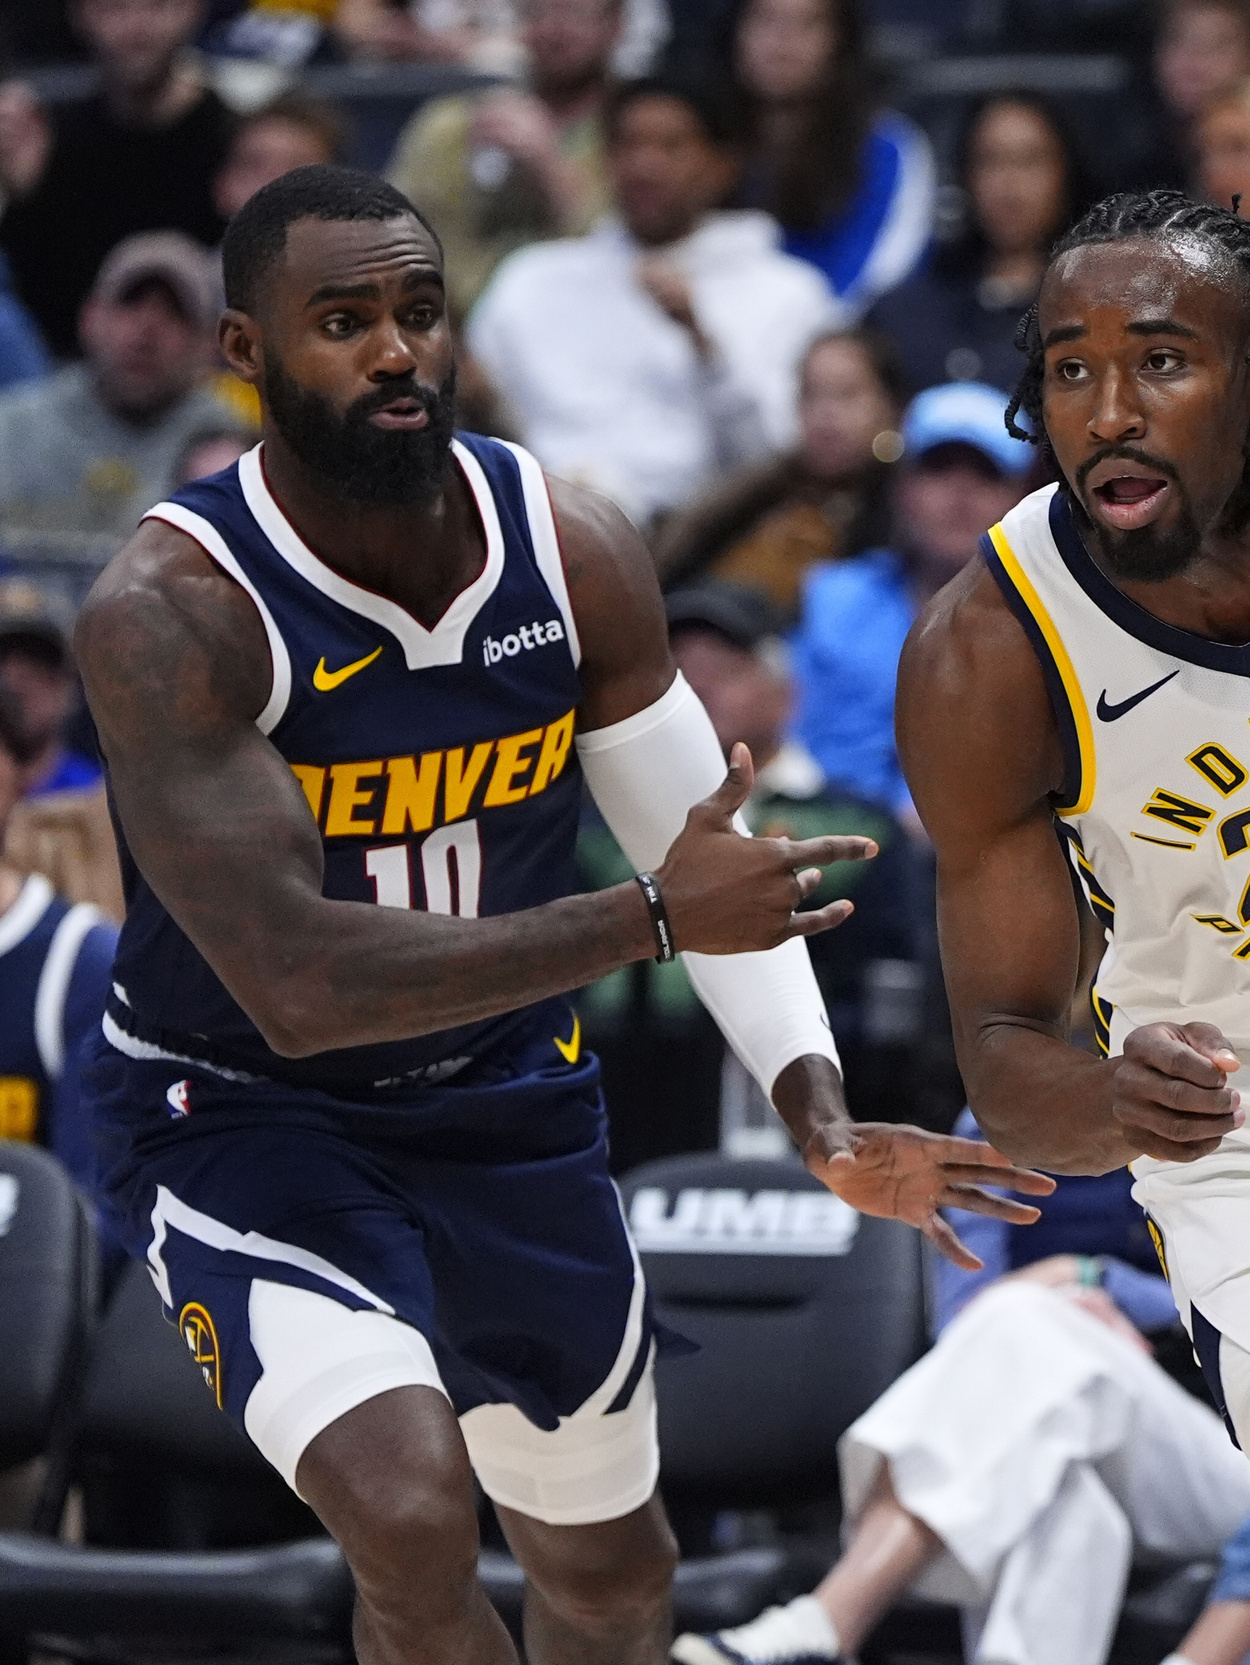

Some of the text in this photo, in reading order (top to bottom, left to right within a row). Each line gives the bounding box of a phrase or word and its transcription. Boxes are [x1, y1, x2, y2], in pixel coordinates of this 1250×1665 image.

[483, 619, 565, 668] ibotta
[364, 817, 483, 919] 10
[630, 1187, 861, 1244] UMB
